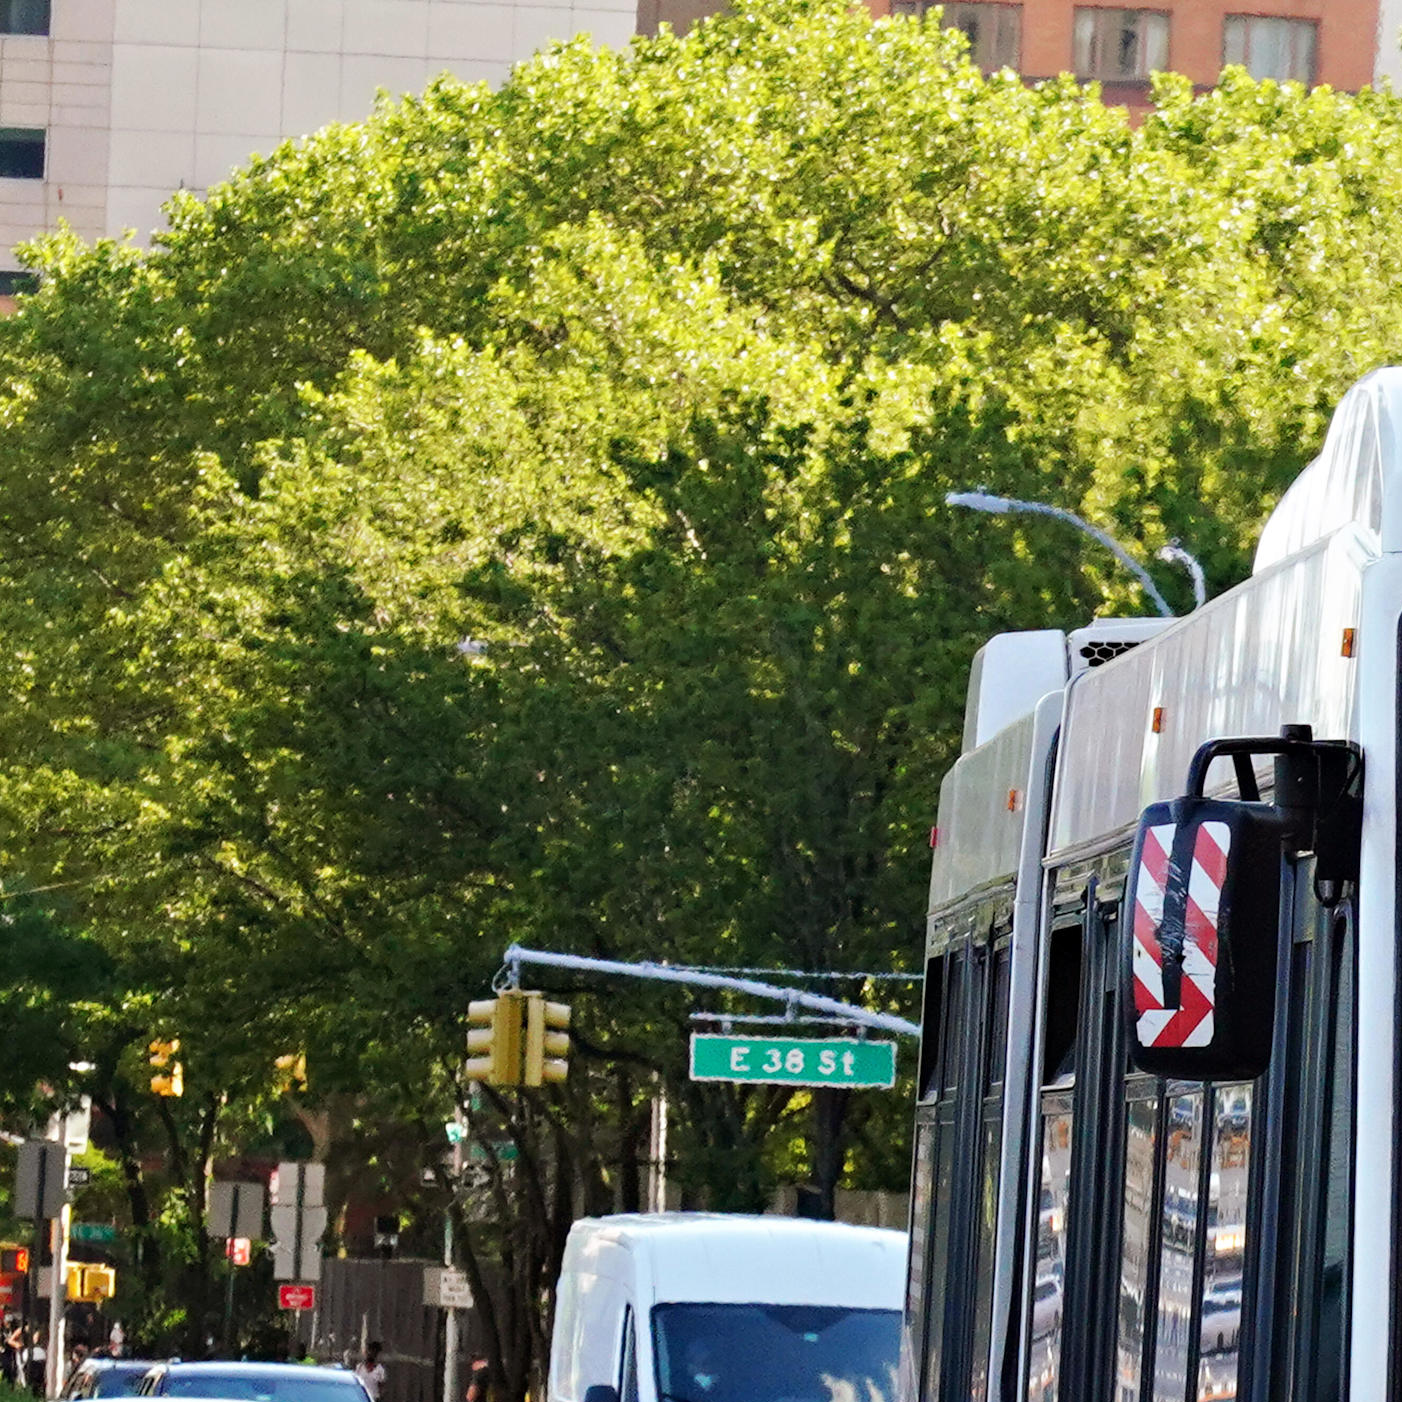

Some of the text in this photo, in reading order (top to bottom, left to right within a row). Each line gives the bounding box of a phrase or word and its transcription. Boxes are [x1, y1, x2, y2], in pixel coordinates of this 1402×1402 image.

[730, 1046, 855, 1077] E 38 St
